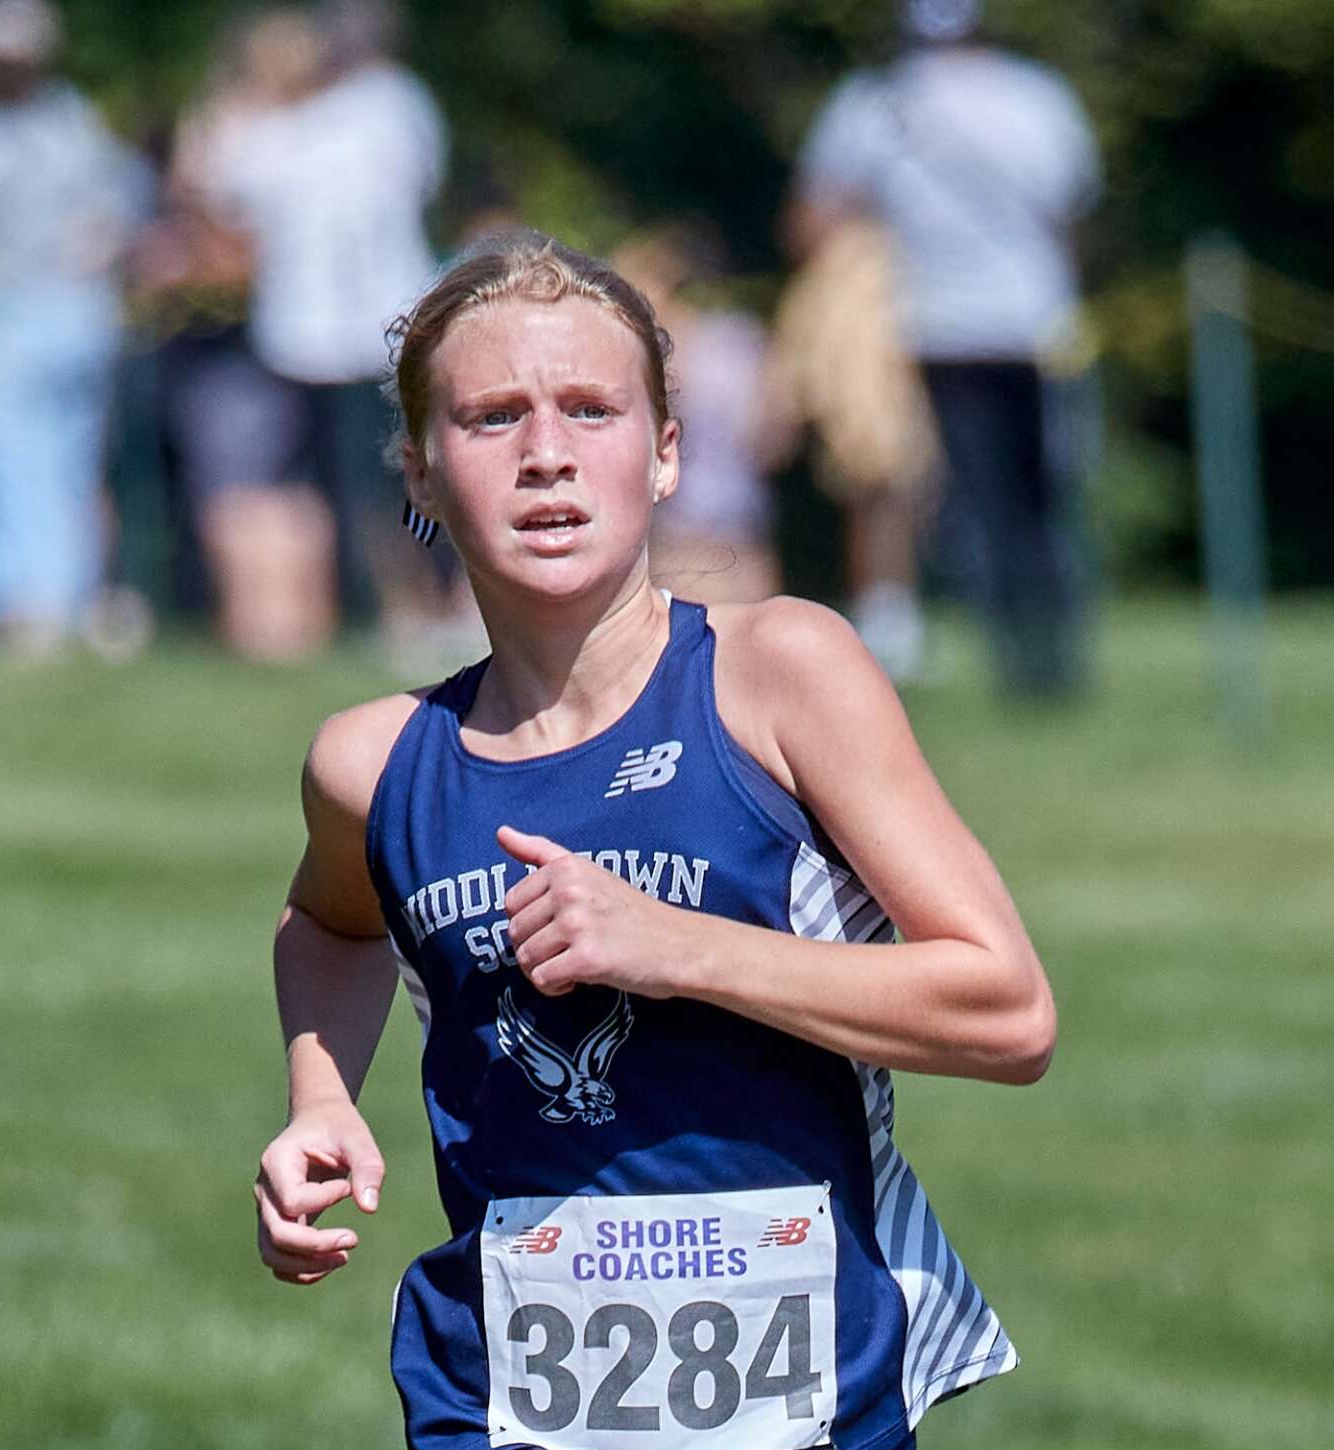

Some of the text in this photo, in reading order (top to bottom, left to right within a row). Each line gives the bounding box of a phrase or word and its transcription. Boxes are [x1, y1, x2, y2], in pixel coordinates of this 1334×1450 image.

[596, 1217, 721, 1249] SHORE
[572, 1247, 748, 1281] COACHES
[507, 1294, 822, 1432] 3284
